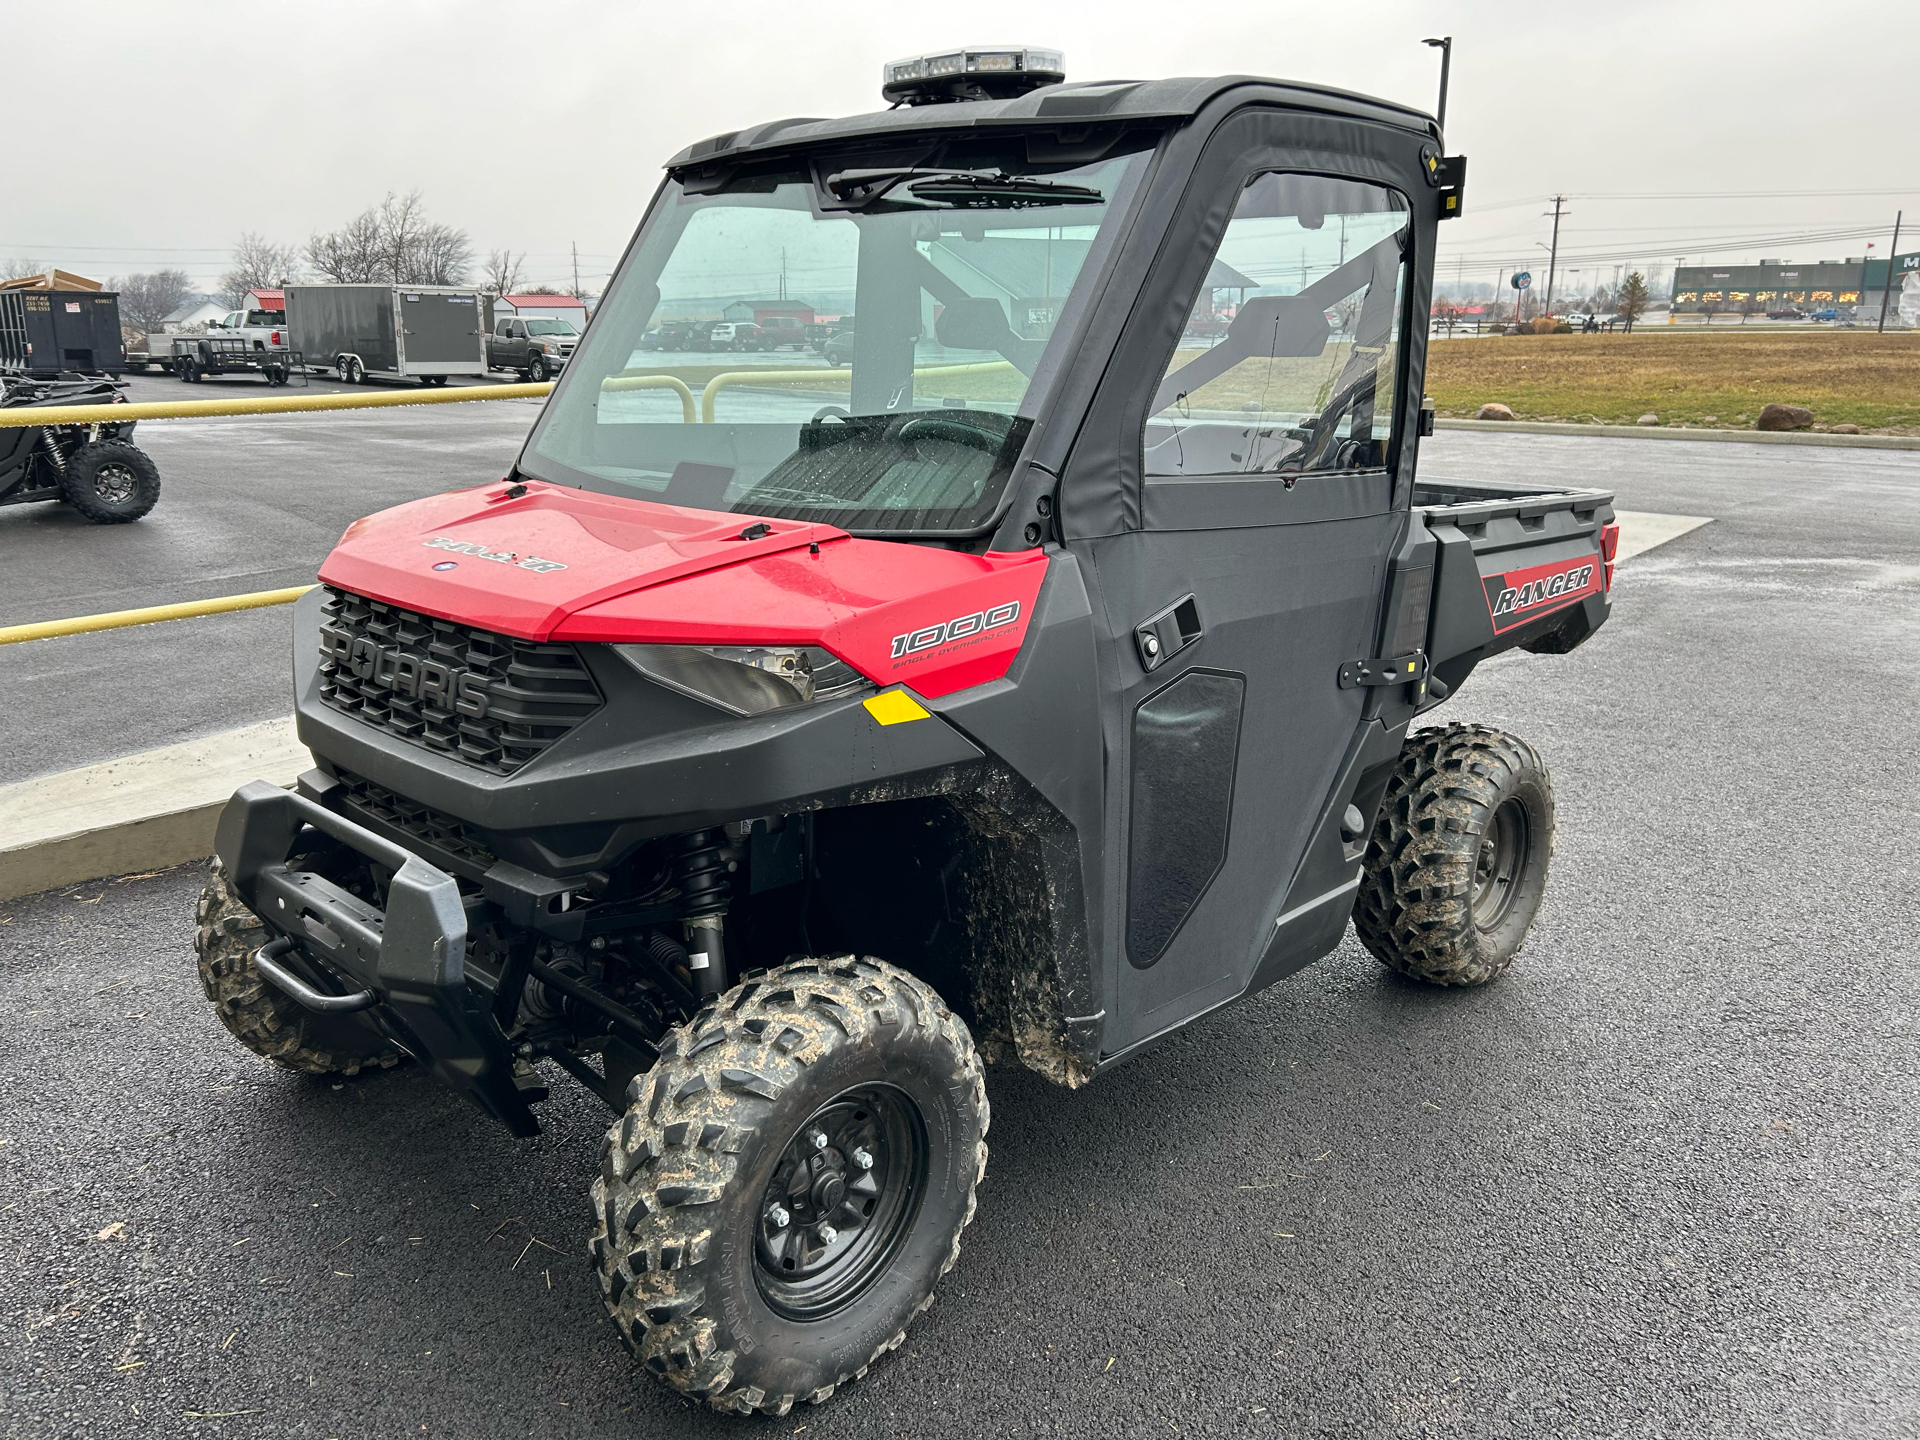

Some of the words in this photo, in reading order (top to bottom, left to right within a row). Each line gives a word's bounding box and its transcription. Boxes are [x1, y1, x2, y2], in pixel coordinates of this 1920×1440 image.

[1492, 564, 1594, 617] RANGER
[890, 600, 1022, 660] 1000
[892, 652, 935, 670] SINGLE
[937, 633, 996, 656] OVERHEAD
[996, 625, 1019, 638] CAM
[331, 627, 490, 720] POLARIS
